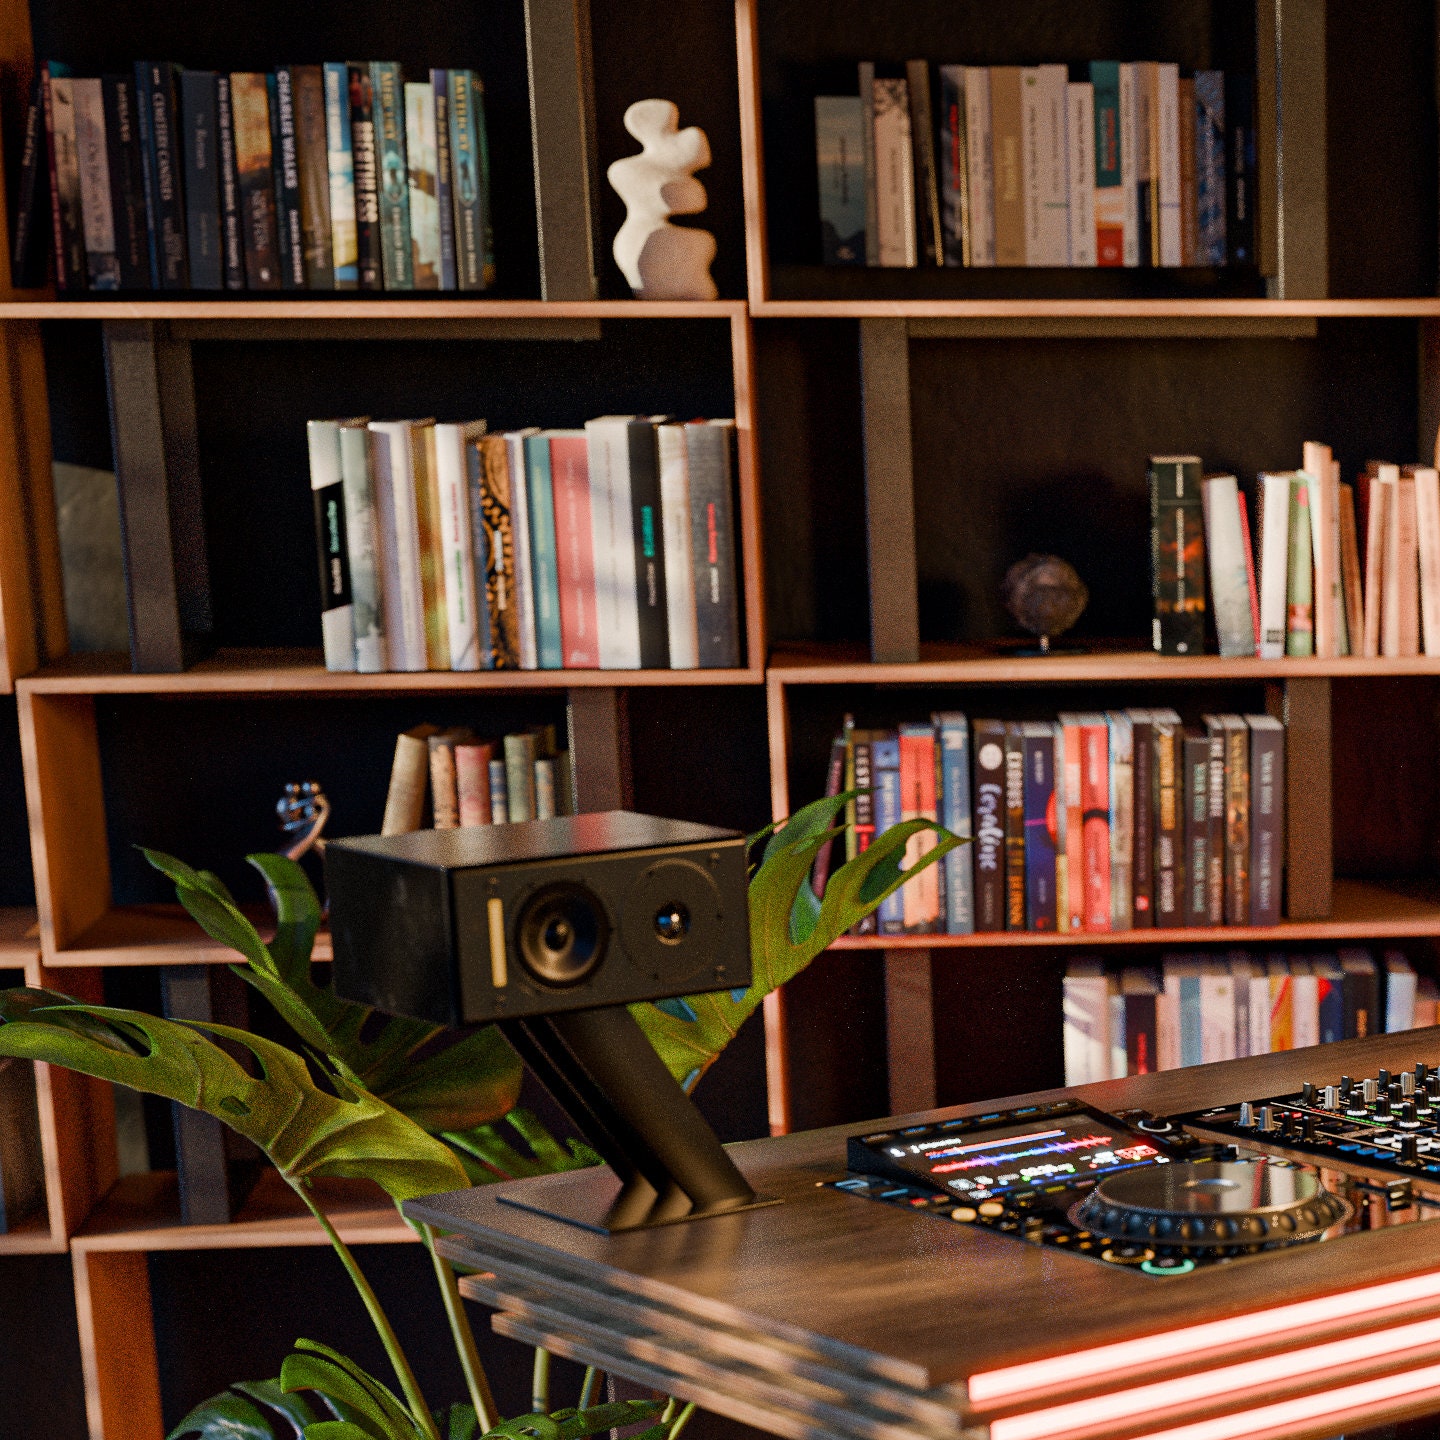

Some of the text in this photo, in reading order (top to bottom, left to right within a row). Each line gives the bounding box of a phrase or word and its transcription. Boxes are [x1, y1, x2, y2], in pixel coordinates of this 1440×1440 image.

[276, 70, 298, 189] CHARLIE WALKS
[855, 745, 871, 825] RESTESS
[1006, 751, 1024, 809] EXODUS
